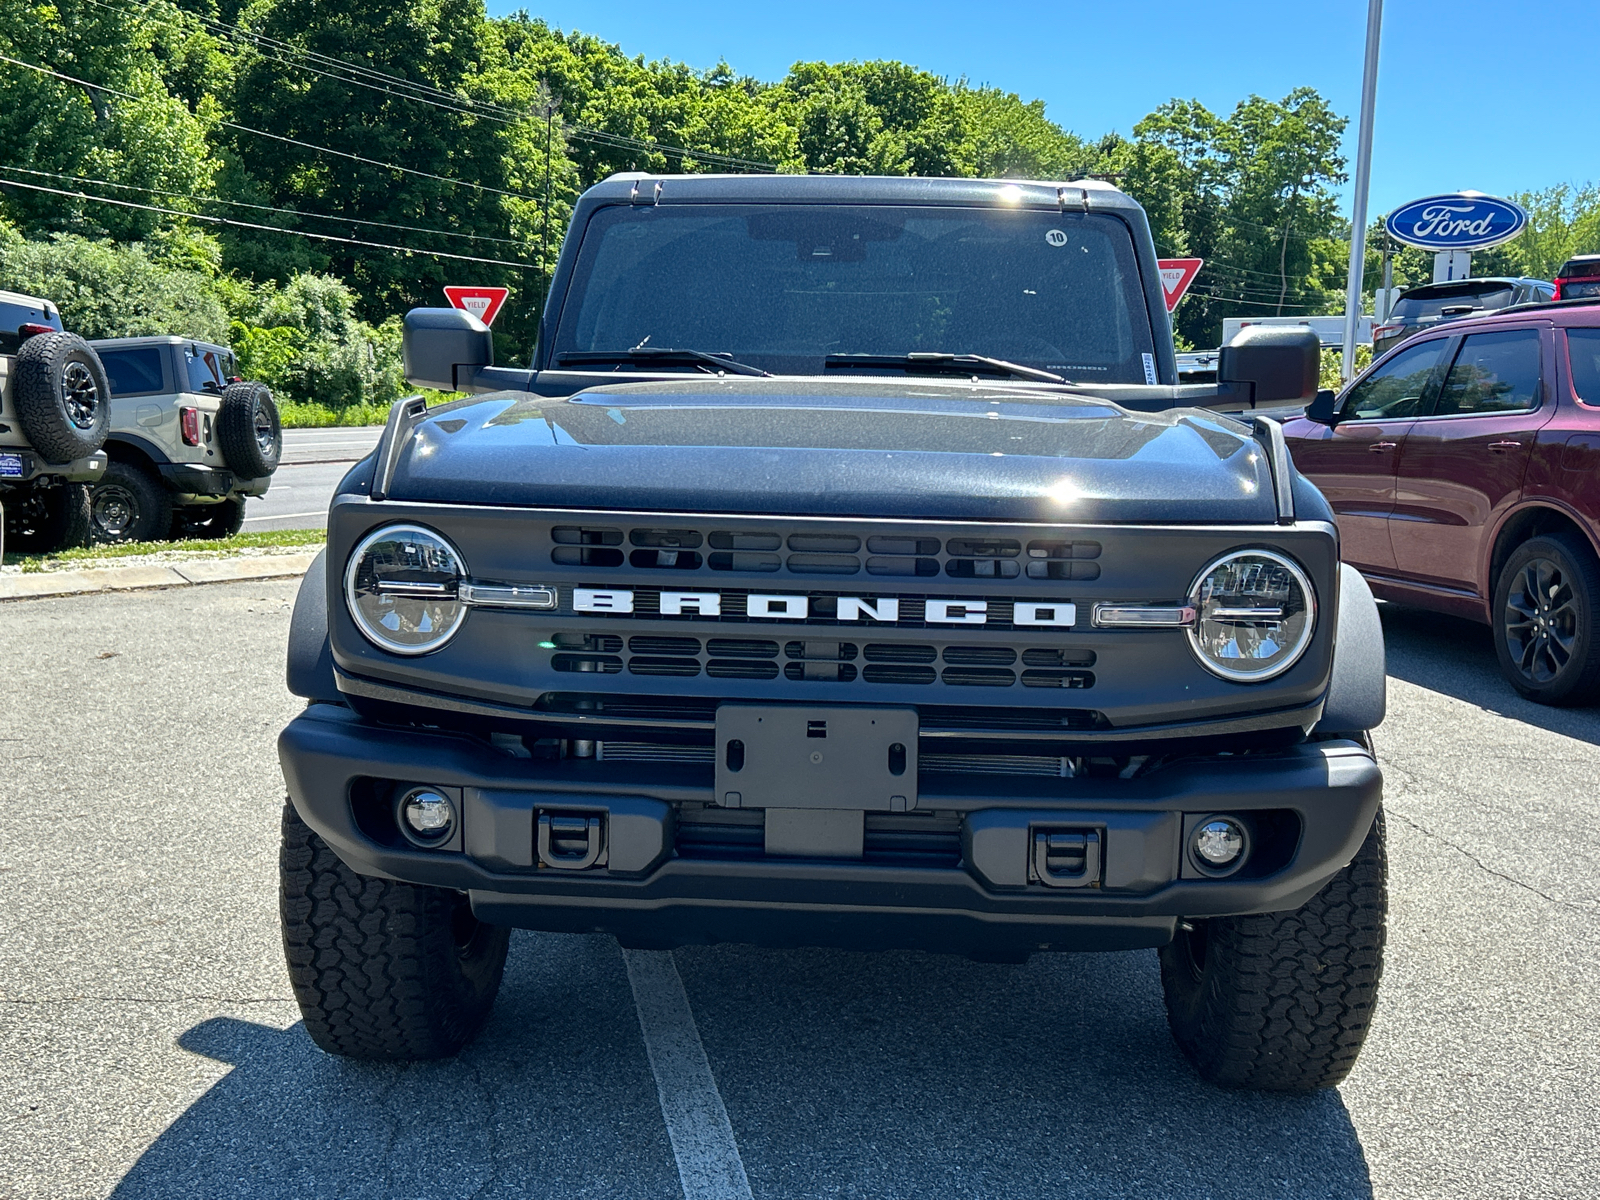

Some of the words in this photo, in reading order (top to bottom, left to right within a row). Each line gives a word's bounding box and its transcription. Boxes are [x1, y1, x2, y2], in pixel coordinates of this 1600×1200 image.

[1413, 205, 1496, 237] Ford
[1050, 232, 1064, 243] 10
[1162, 272, 1180, 280] YIELD
[573, 588, 1077, 626] BRONCO
